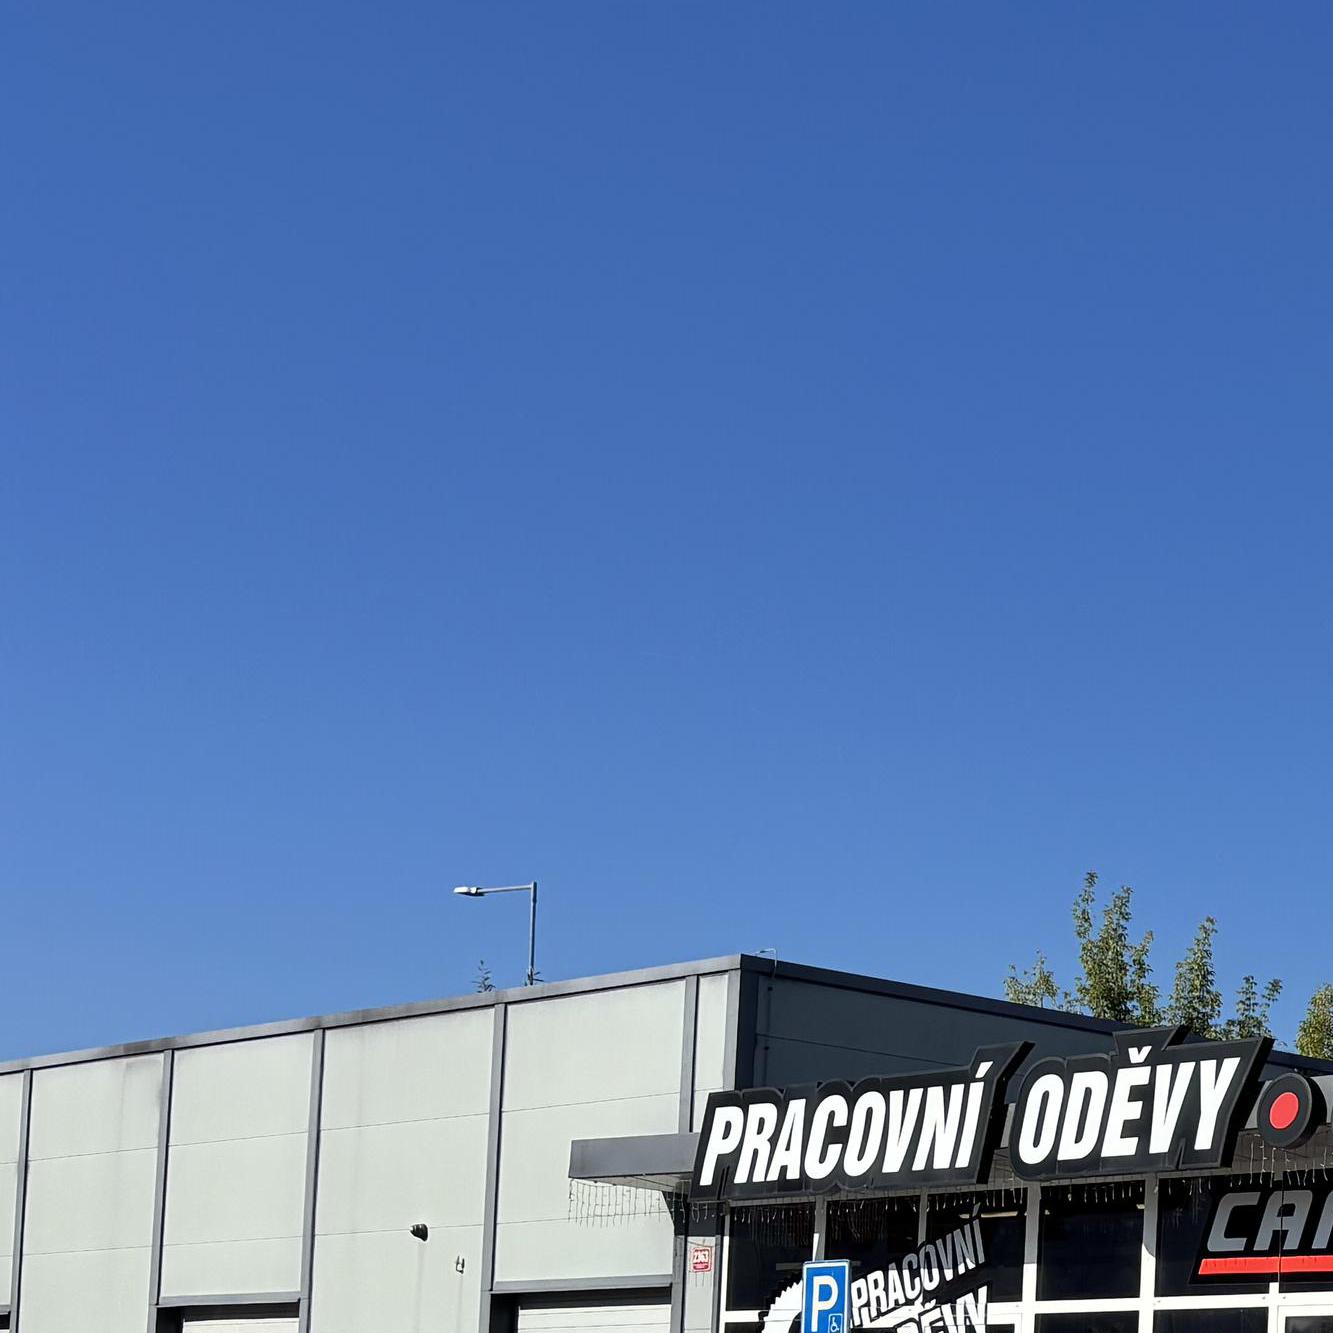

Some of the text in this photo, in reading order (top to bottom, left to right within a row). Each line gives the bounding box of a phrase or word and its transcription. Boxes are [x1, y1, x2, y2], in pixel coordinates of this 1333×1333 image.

[700, 1060, 993, 1187] PRACOVNÍ
[1017, 1045, 1243, 1165] ODĚVY
[810, 1274, 839, 1333] P
[850, 1203, 987, 1327] PRACOVNÍ
